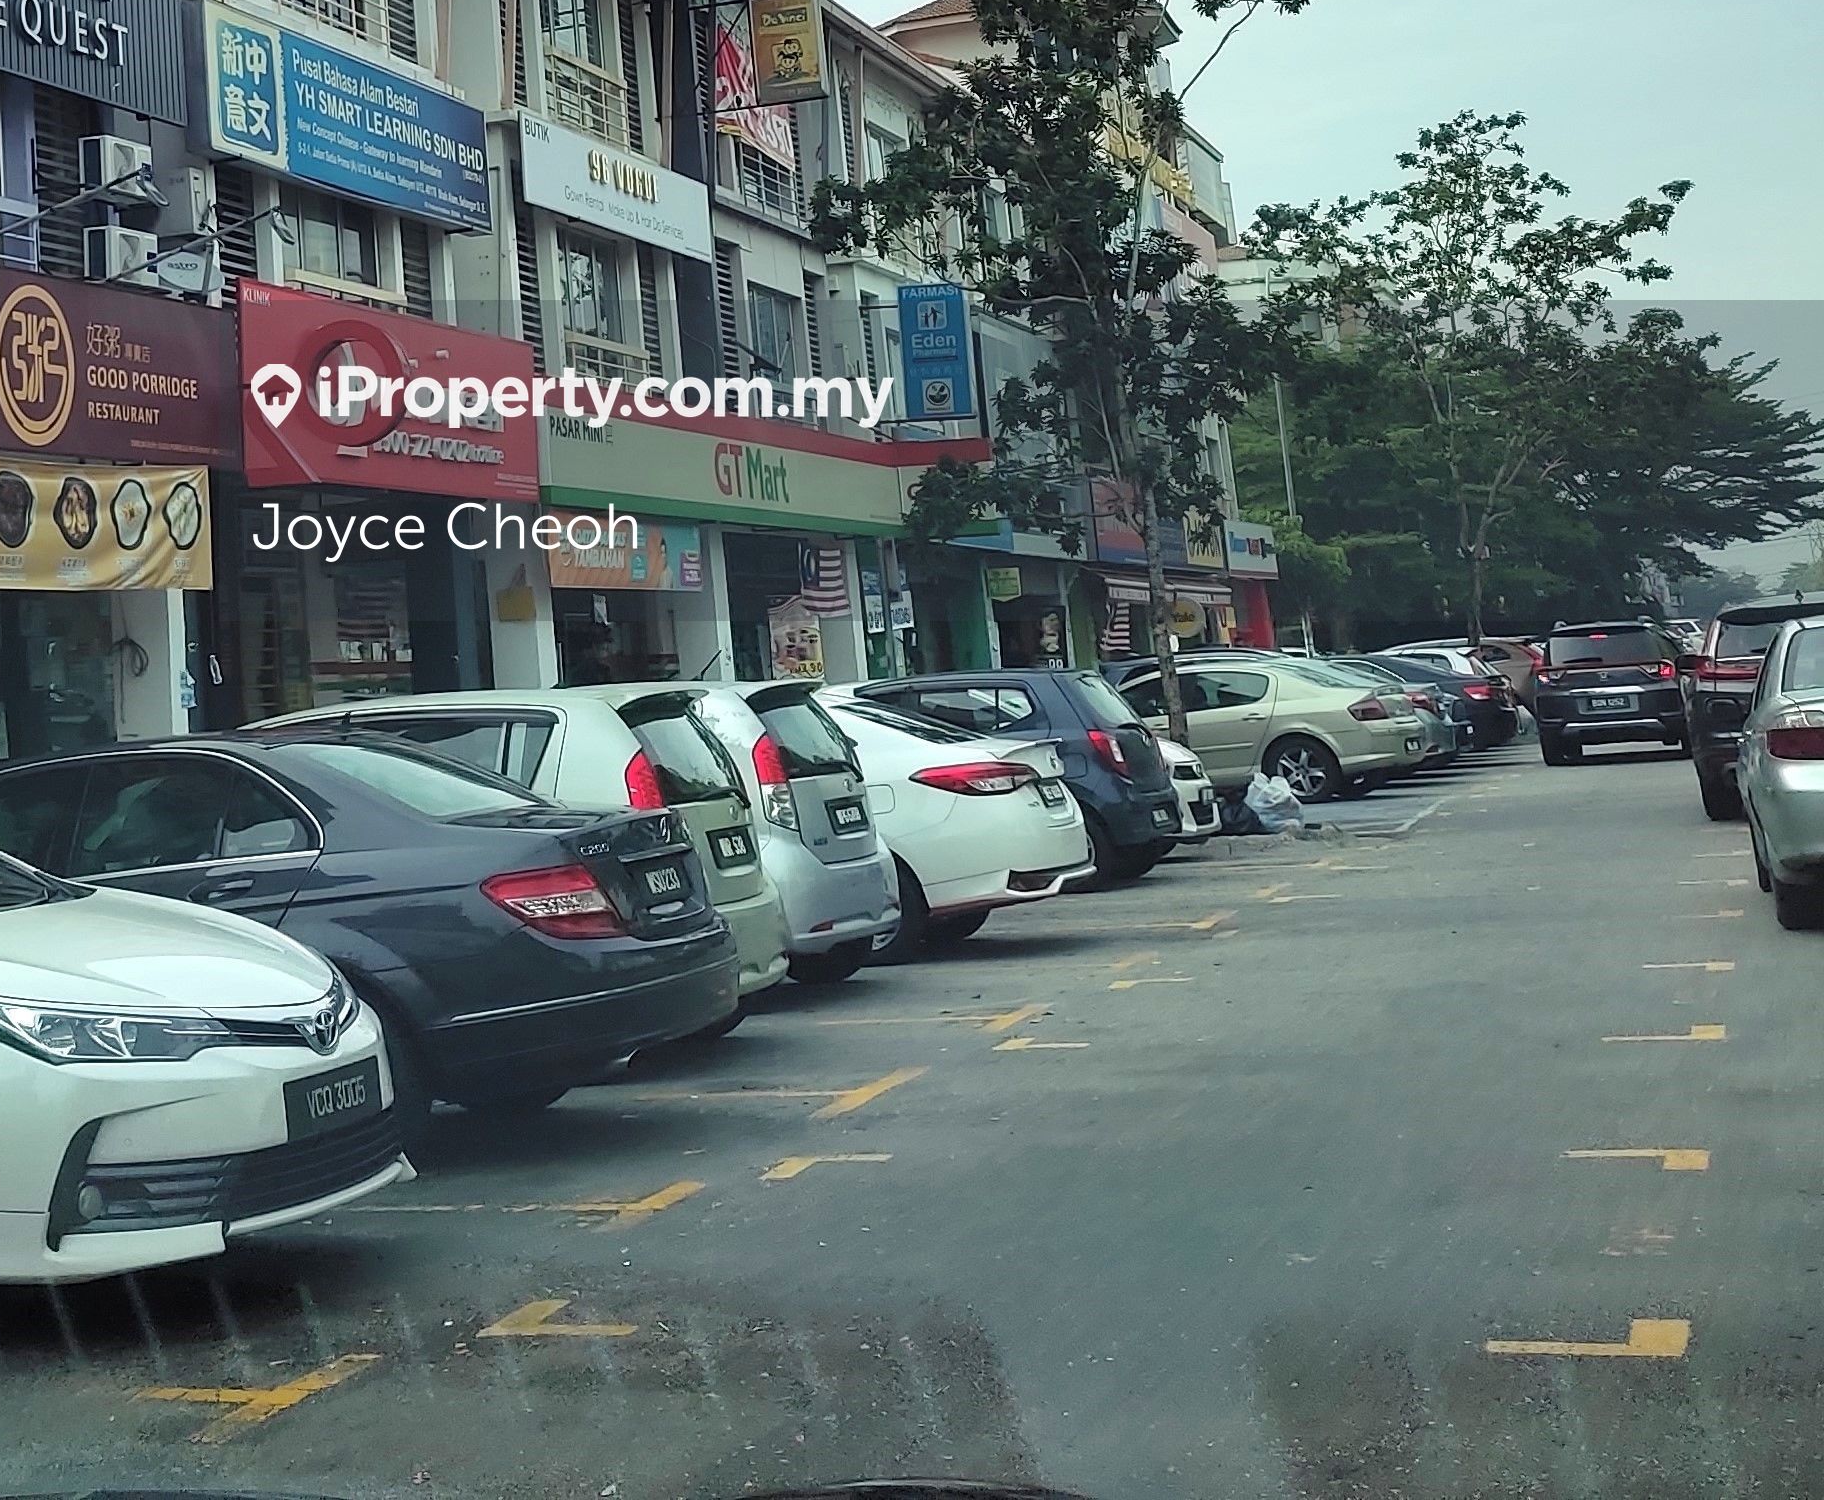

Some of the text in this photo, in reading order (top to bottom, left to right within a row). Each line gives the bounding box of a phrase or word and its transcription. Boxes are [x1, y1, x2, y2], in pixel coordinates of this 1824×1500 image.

[292, 48, 420, 119] Pusat Bahasa Alam Bestari
[295, 80, 485, 172] YH SMART LEARNING SDN BHD
[312, 122, 336, 143] Concept
[525, 118, 550, 143] BUTIK
[589, 149, 609, 184] 96
[243, 287, 271, 307] KLINIK
[902, 285, 959, 299] FARMASI
[911, 333, 956, 349] Eden
[87, 365, 198, 400] GOOD PORRIDGE
[87, 401, 160, 426] RESTAURANT
[550, 415, 580, 440] PASAR
[745, 446, 790, 503] Mart
[306, 1074, 366, 1120] VCQ 3005
